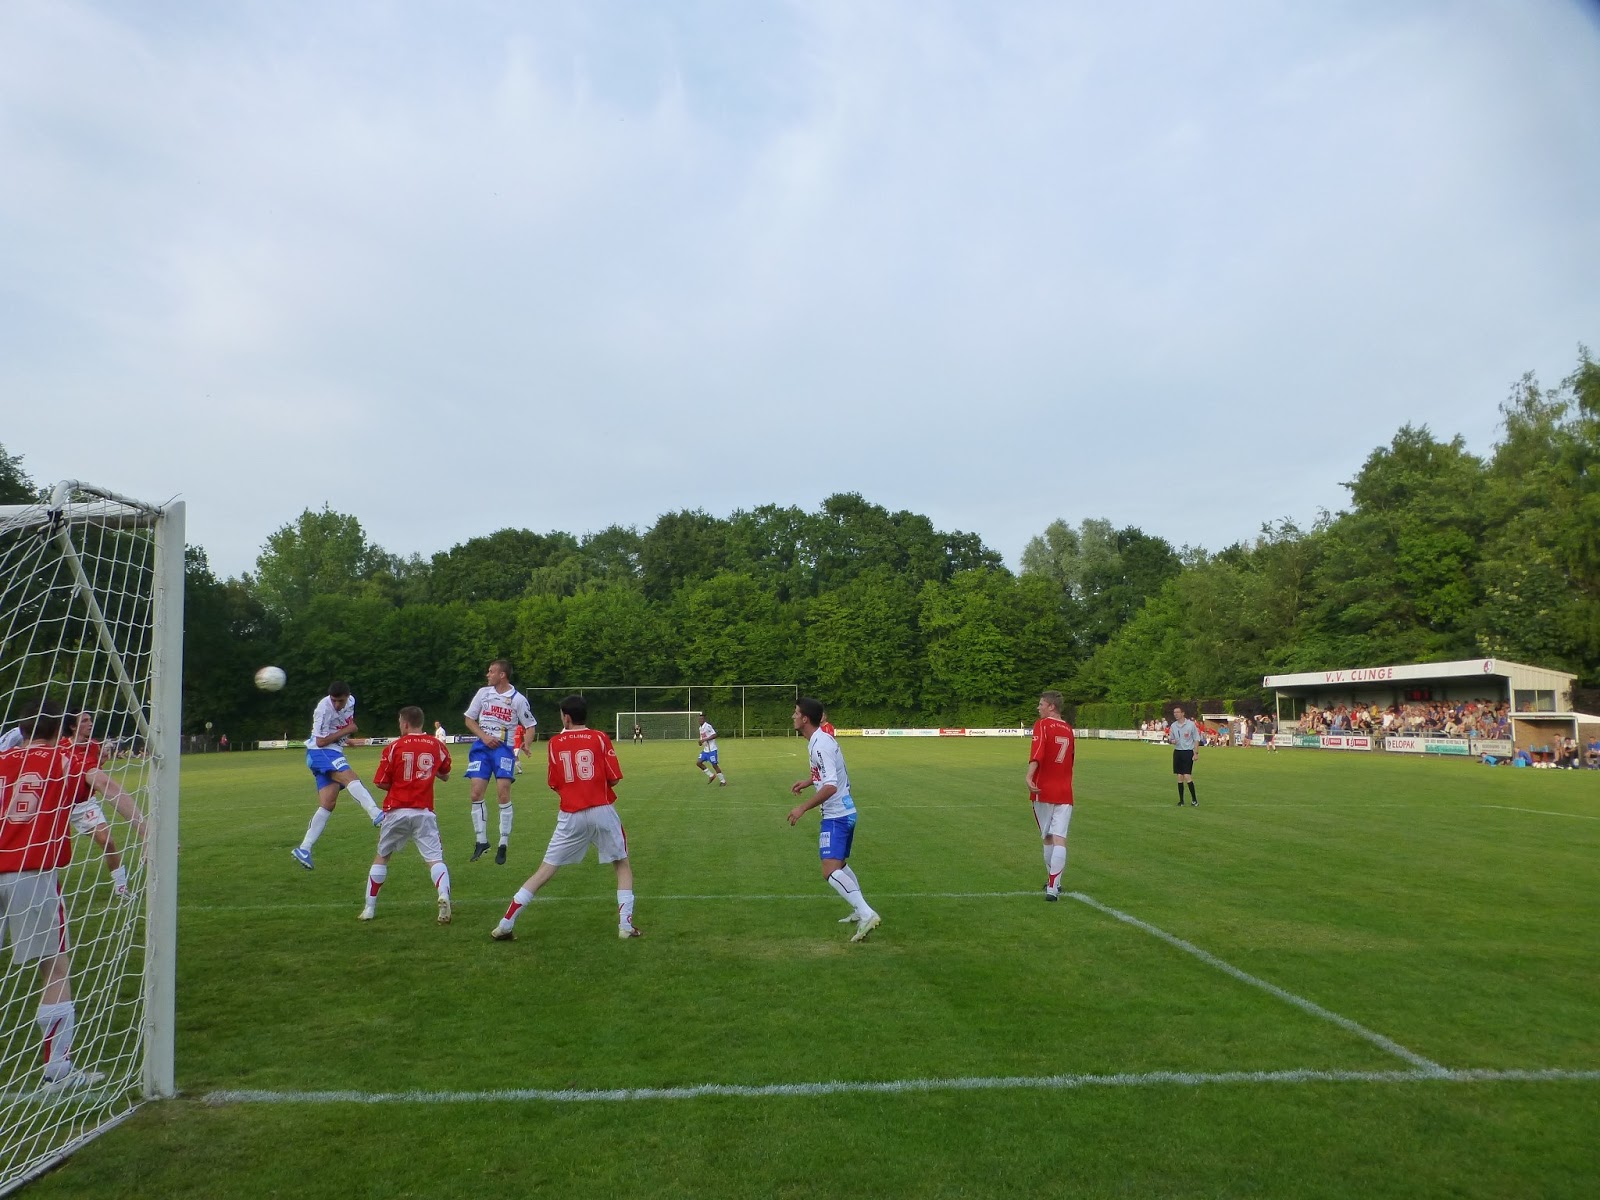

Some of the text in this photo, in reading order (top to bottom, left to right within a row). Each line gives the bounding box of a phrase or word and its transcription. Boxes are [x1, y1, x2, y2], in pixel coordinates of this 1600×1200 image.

[1325, 668, 1393, 683] V.V. CLINGE
[491, 705, 512, 716] WILLY
[1054, 736, 1070, 764] 7
[1392, 740, 1415, 749] ELOPAK
[12, 750, 49, 759] CLGE
[402, 751, 434, 782] 19
[559, 748, 595, 783] 18
